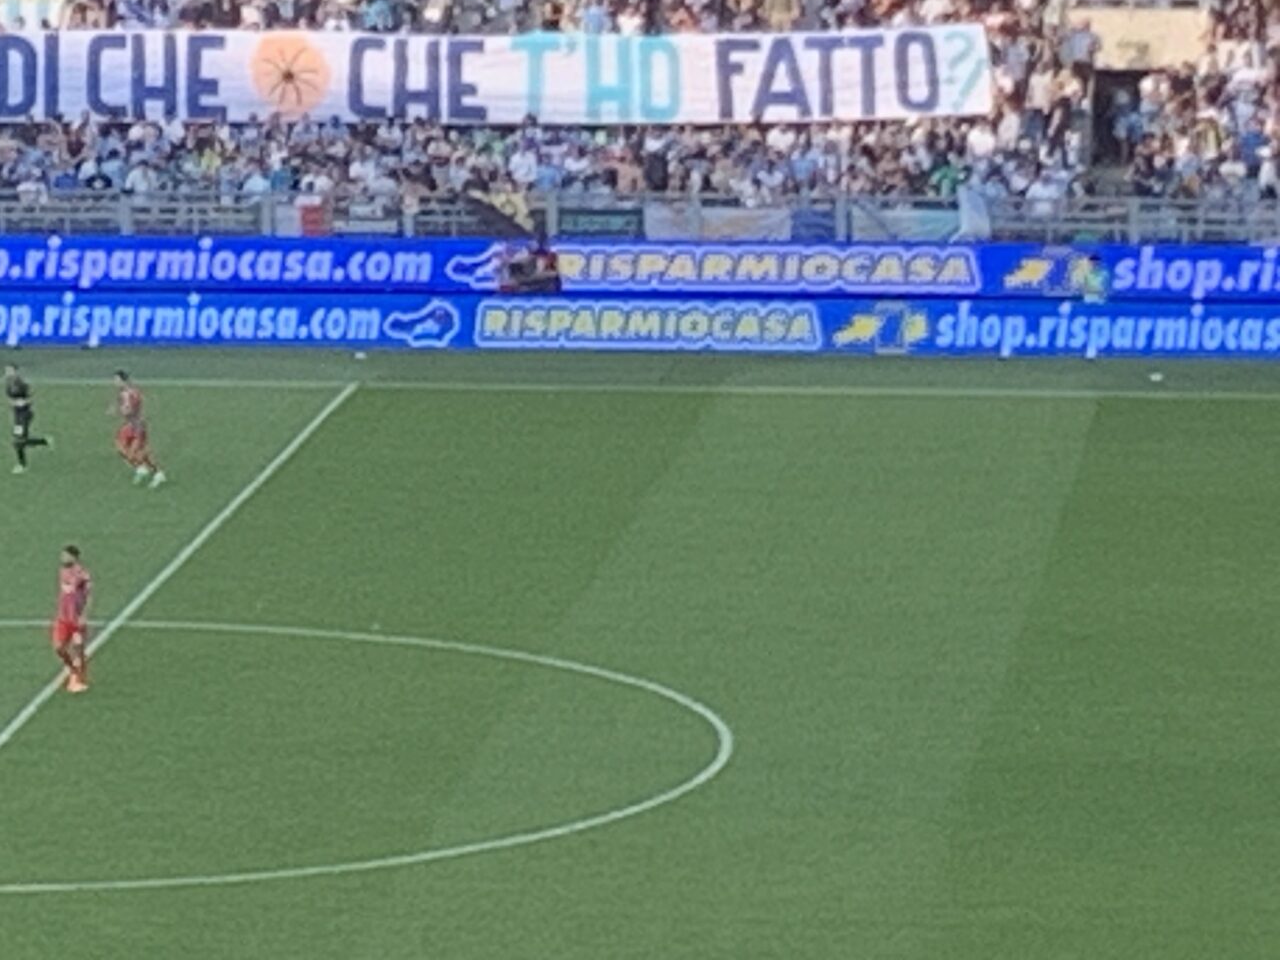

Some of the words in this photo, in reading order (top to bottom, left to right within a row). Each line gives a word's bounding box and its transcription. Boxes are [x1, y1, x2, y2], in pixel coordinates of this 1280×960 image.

[87, 35, 227, 120] CHE
[348, 38, 488, 120] CHE
[546, 249, 973, 283] RISPARMIOCASA
[1113, 245, 1280, 300] shop.ri
[483, 306, 817, 341] RISPARMIOCASA
